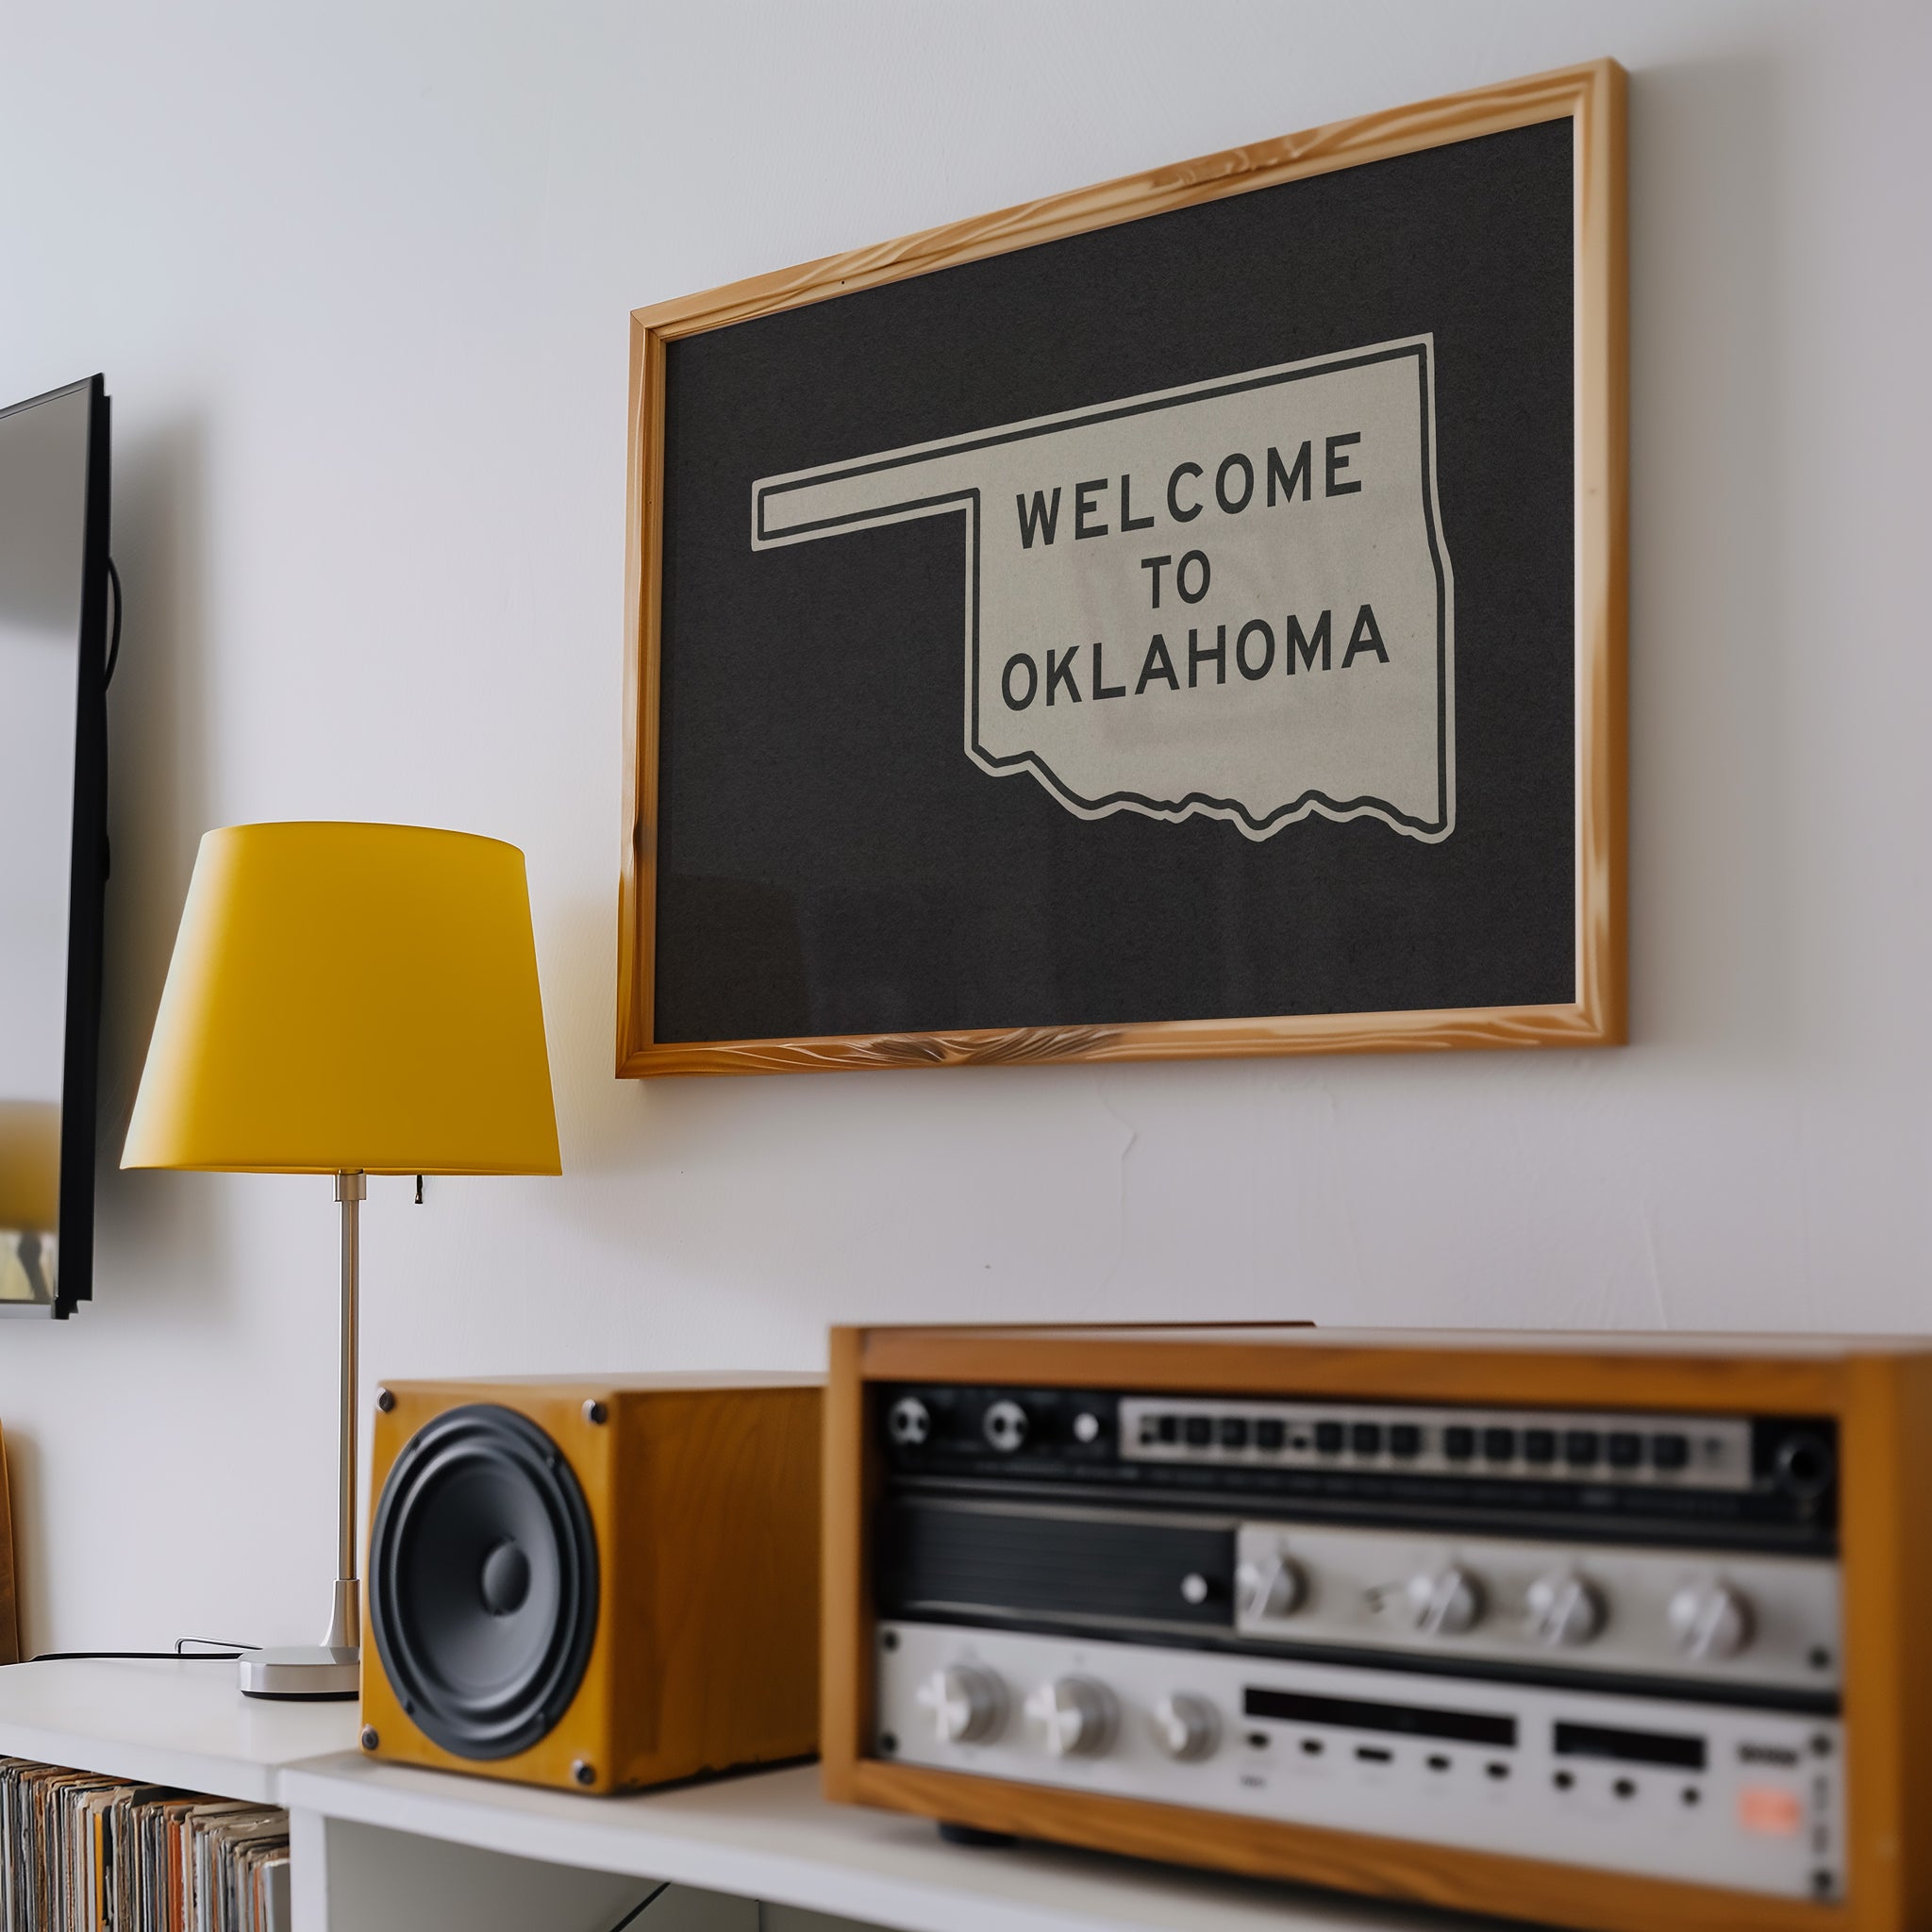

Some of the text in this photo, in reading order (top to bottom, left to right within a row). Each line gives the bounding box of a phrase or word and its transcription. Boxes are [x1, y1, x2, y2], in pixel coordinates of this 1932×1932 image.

[1016, 431, 1362, 549] WELCOME
[1141, 550, 1211, 608] TO
[1001, 604, 1391, 711] OKLAHOMA
